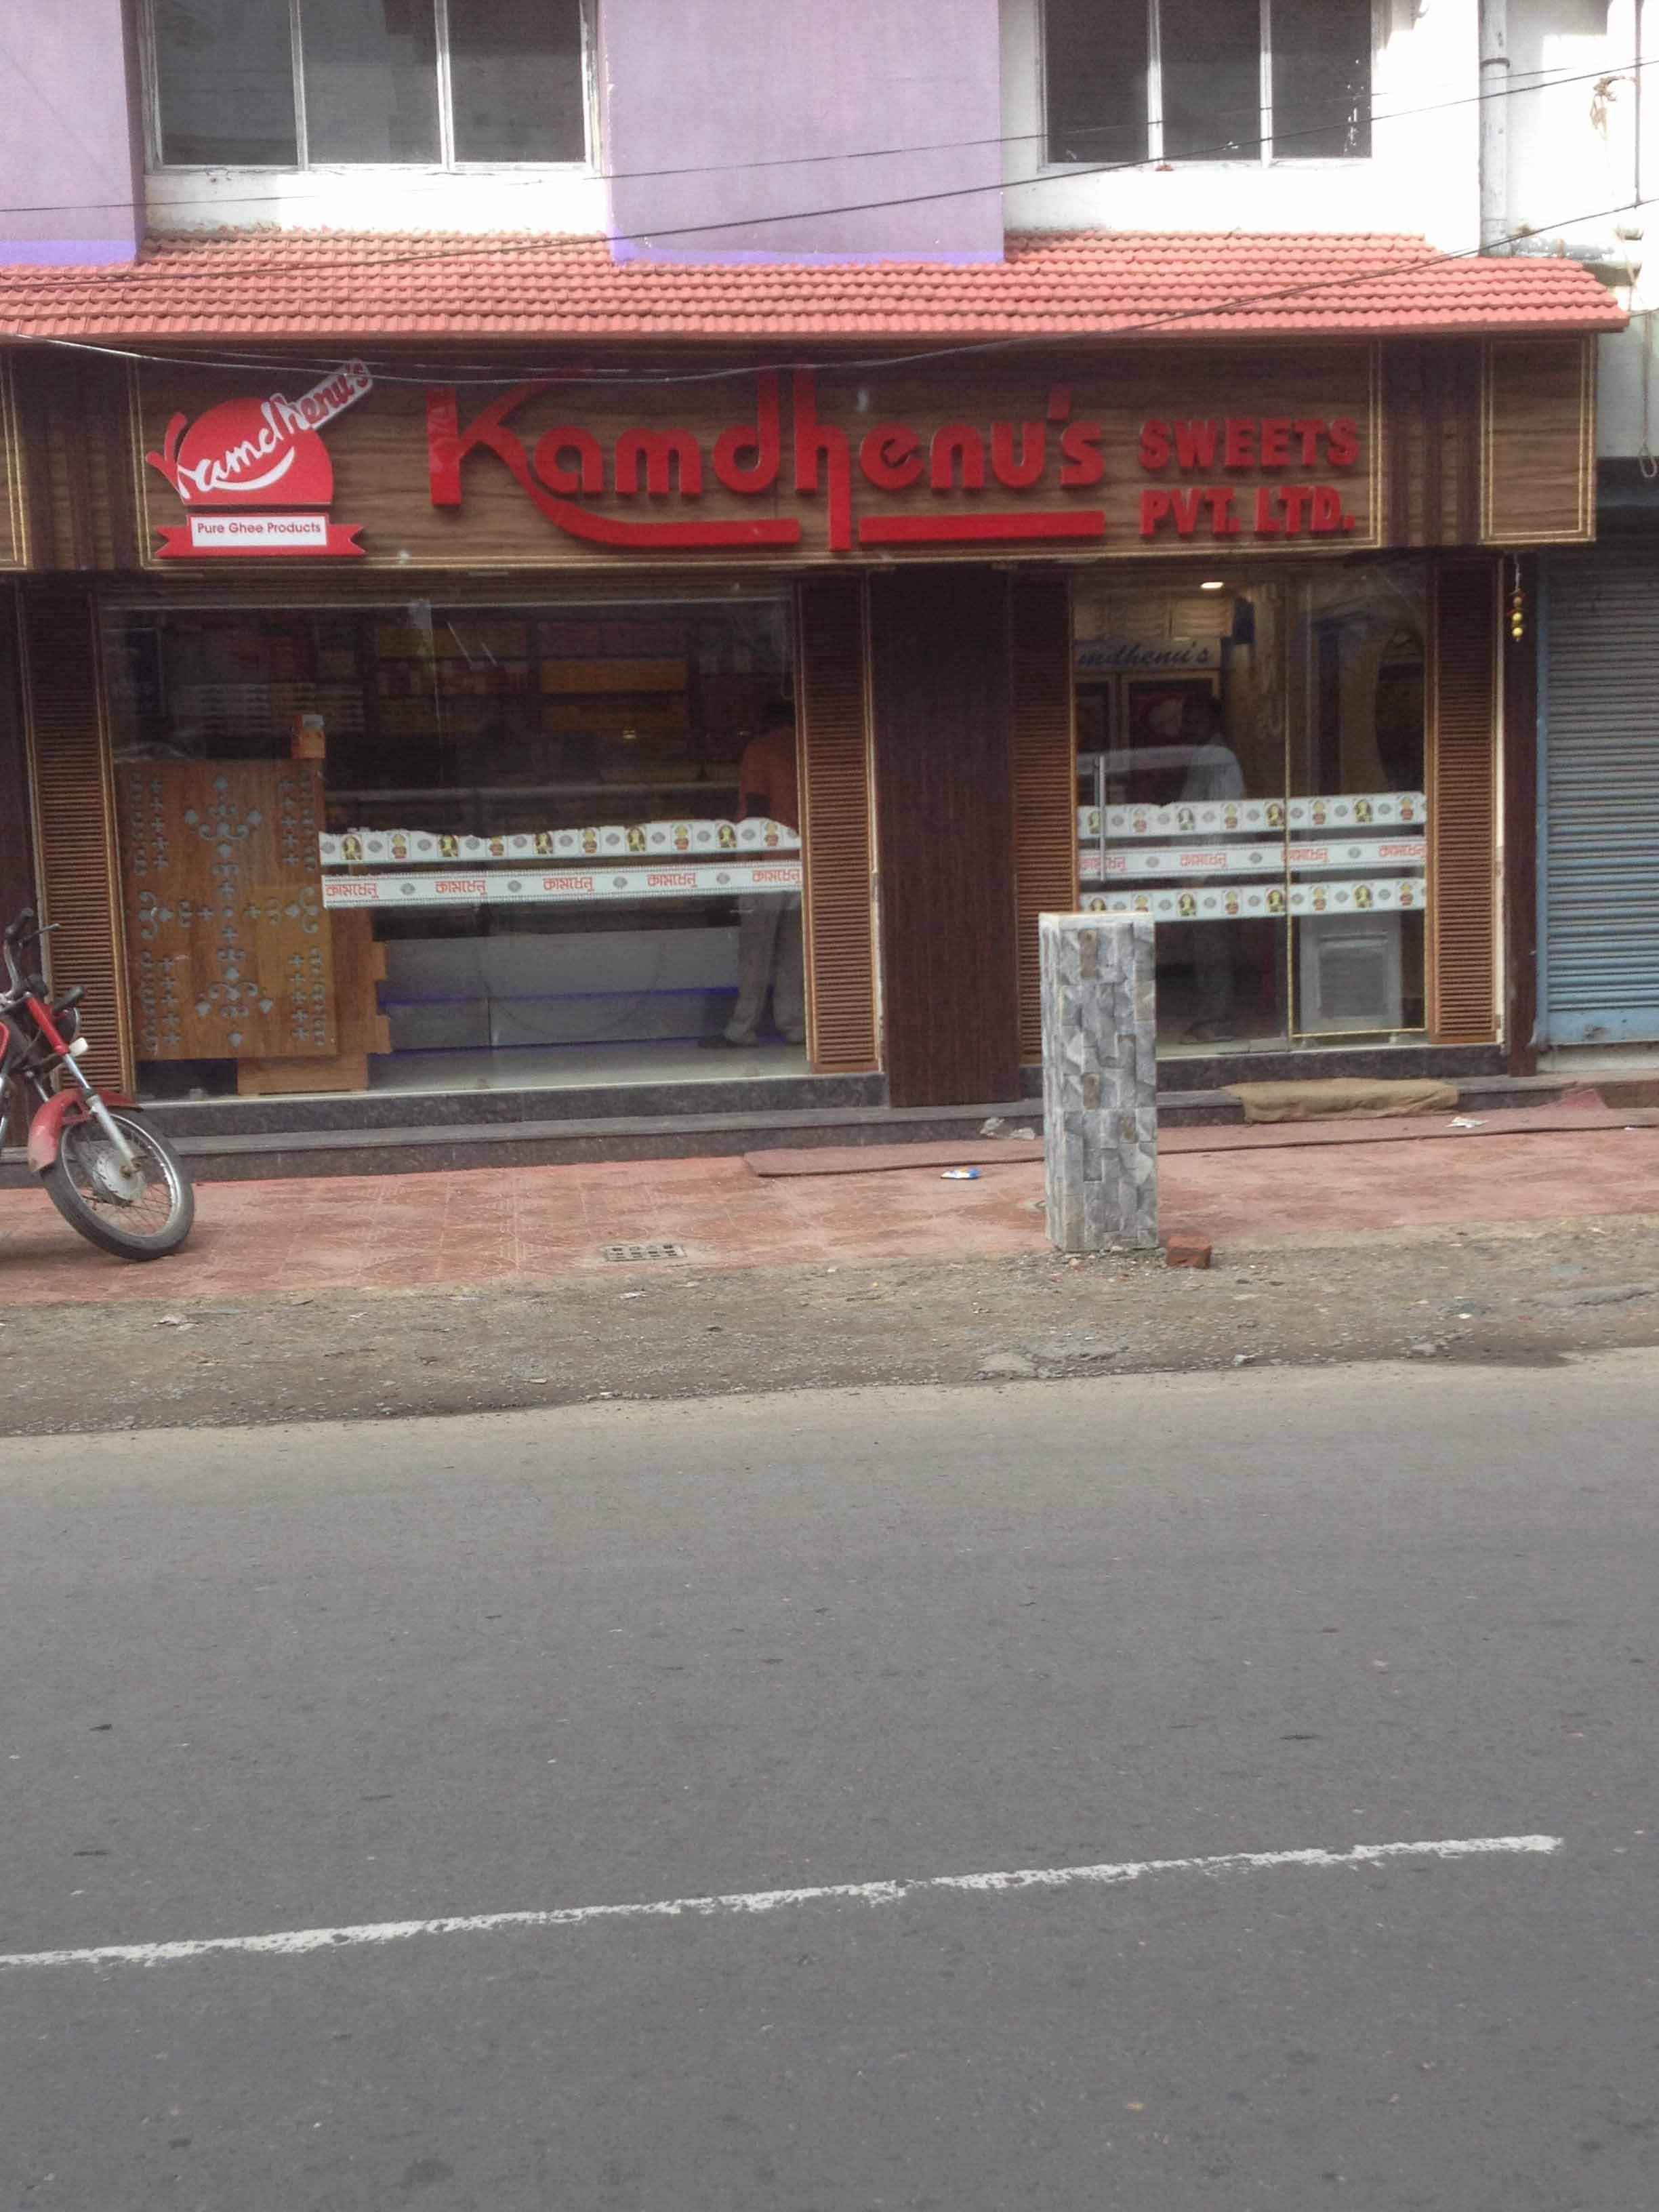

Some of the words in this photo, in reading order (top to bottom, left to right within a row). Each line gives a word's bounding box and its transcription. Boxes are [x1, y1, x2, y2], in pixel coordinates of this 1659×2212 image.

[145, 359, 371, 499] Kamdhenu's
[1139, 417, 1359, 468] SWEETS
[426, 362, 1105, 551] Kamdhenu's
[197, 523, 225, 533] Pure
[228, 523, 264, 533] Ghee
[268, 522, 321, 533] Products
[1139, 487, 1242, 536] PVT.
[1254, 485, 1355, 533] LTD.
